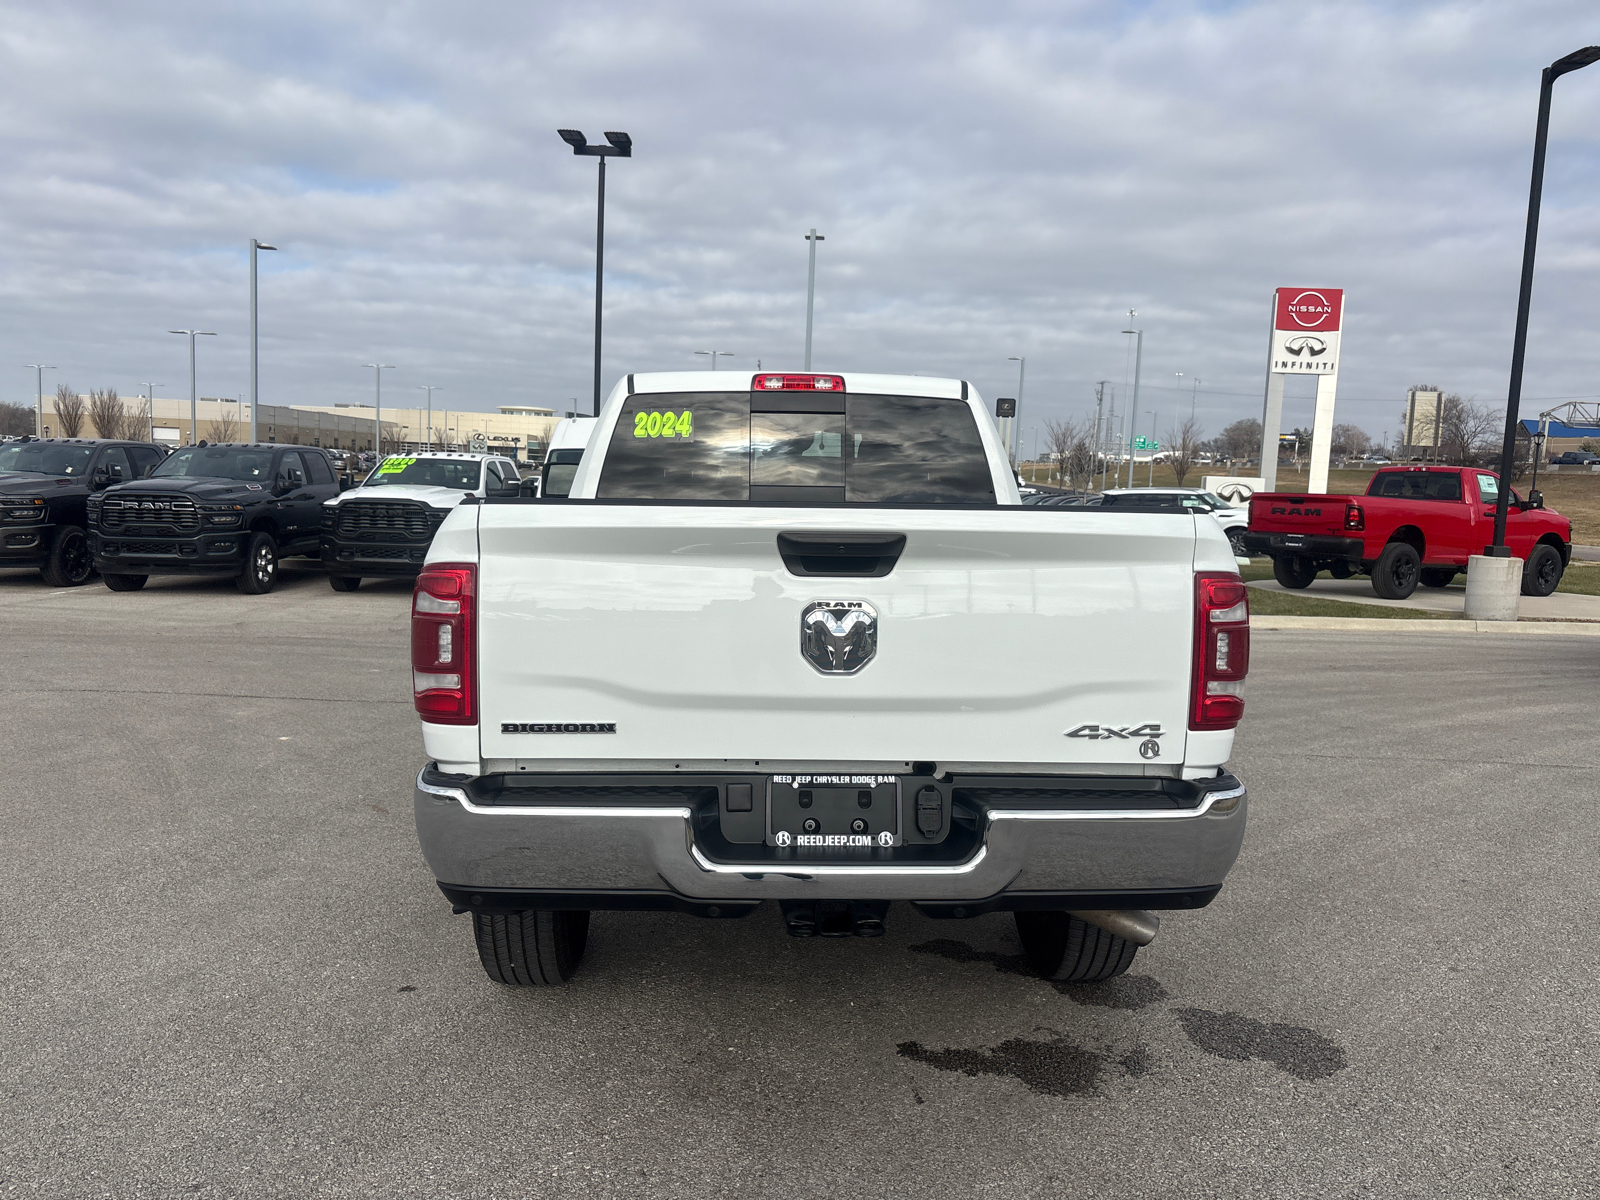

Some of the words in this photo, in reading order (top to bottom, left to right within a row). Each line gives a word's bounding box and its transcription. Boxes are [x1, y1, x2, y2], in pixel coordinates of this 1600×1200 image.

[1288, 305, 1332, 313] NISSAN
[1274, 360, 1335, 371] INFINITI
[633, 410, 693, 439] 2024
[123, 501, 171, 510] RAM
[1271, 507, 1322, 517] RAM
[500, 721, 617, 734] BIGHORN
[773, 775, 792, 784] REED
[795, 775, 812, 784] JEEP
[813, 775, 850, 784] CHRYSLER
[851, 775, 876, 784] DODGE
[877, 775, 895, 784] RAM
[797, 835, 872, 846] REEDJEEP.COM
